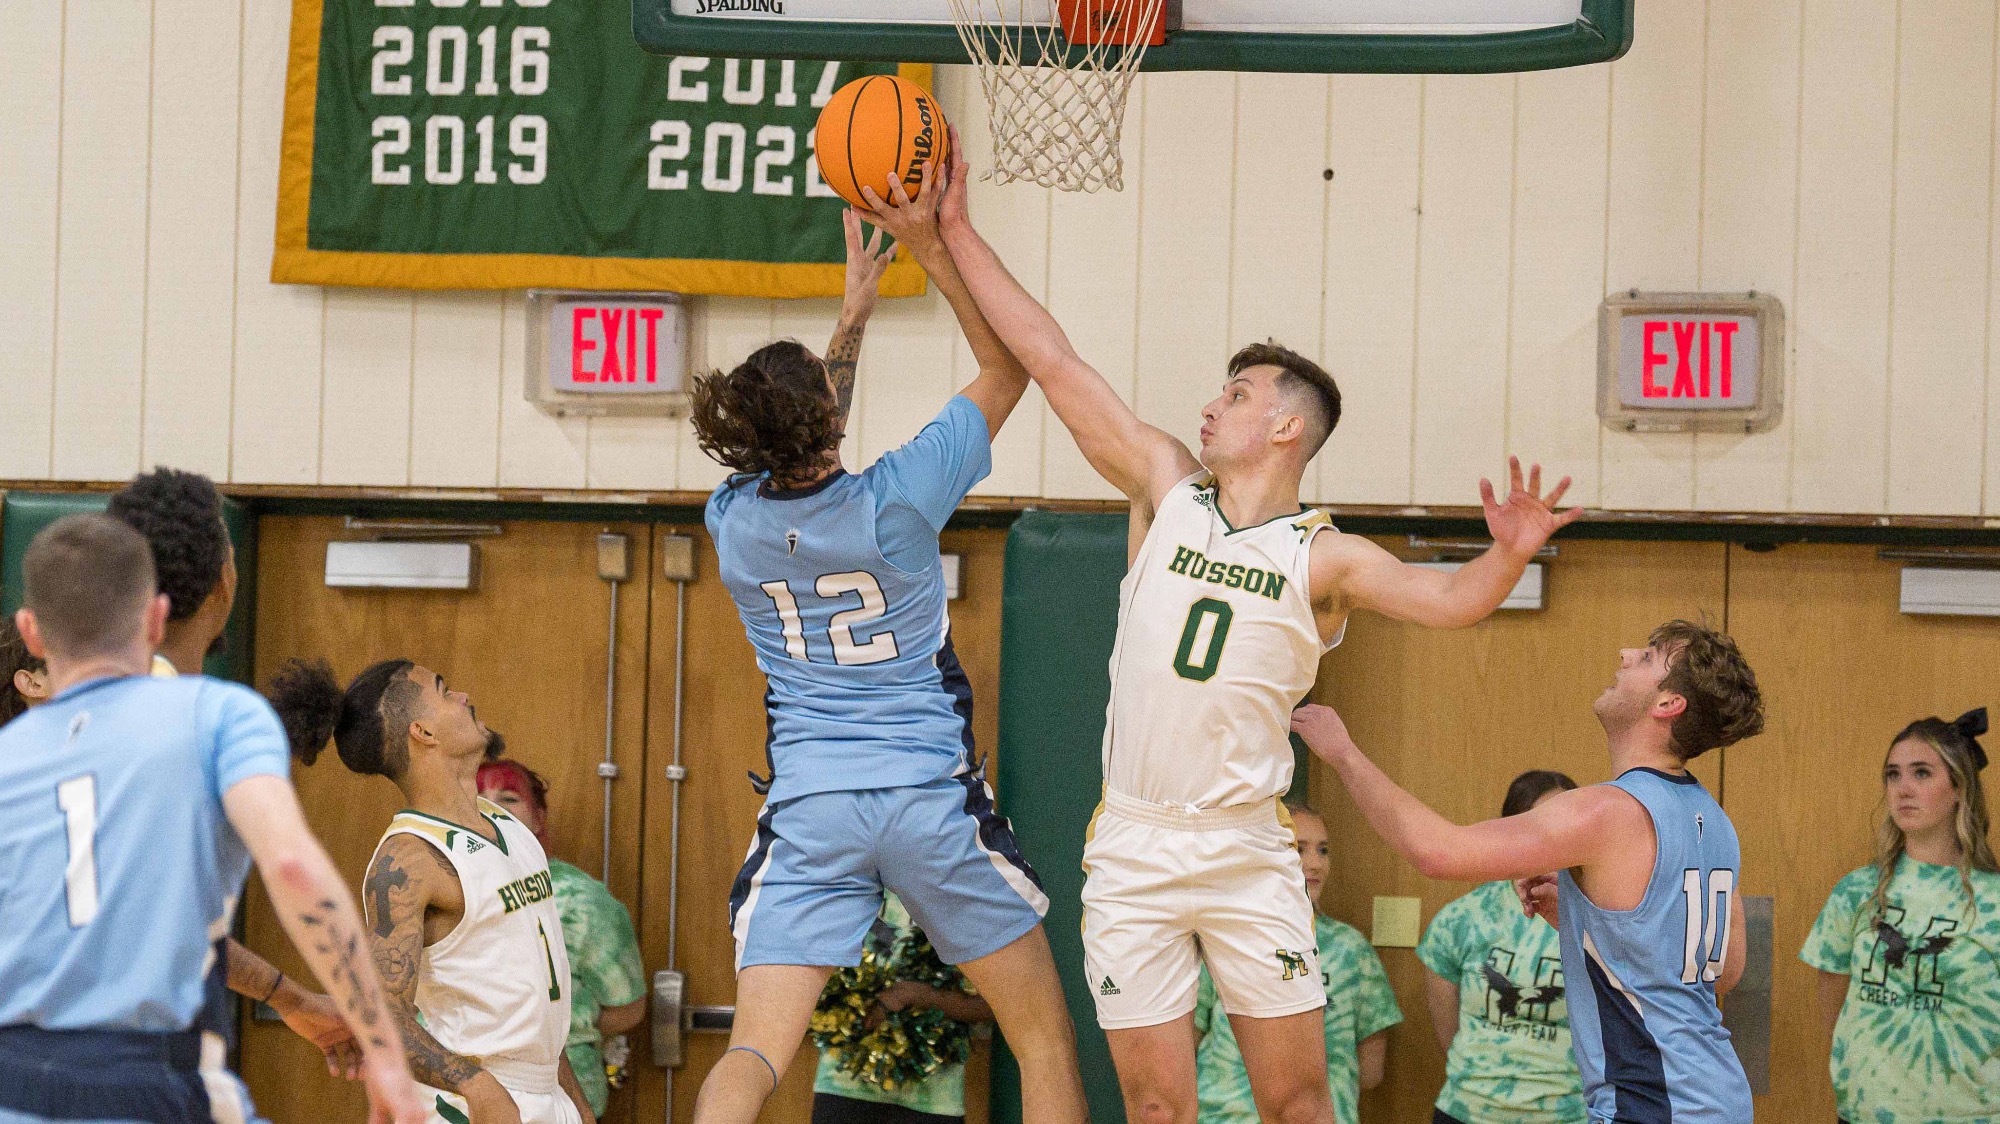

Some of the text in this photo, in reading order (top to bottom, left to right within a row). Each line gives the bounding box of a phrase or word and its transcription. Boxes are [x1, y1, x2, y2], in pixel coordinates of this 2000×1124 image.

[697, 0, 782, 15] SPALDING
[371, 25, 551, 95] 2016
[371, 114, 548, 185] 2019
[903, 96, 933, 184] Wilson
[572, 308, 664, 383] EXIT
[1642, 321, 1739, 398] EXIT
[1167, 543, 1289, 602] HUSSON
[759, 569, 900, 666] 12
[1171, 595, 1236, 684] 0
[56, 771, 98, 928] 1
[537, 916, 561, 1002] 1
[1680, 868, 1734, 985] 10
[1860, 985, 1943, 1014] CHEER TEAM
